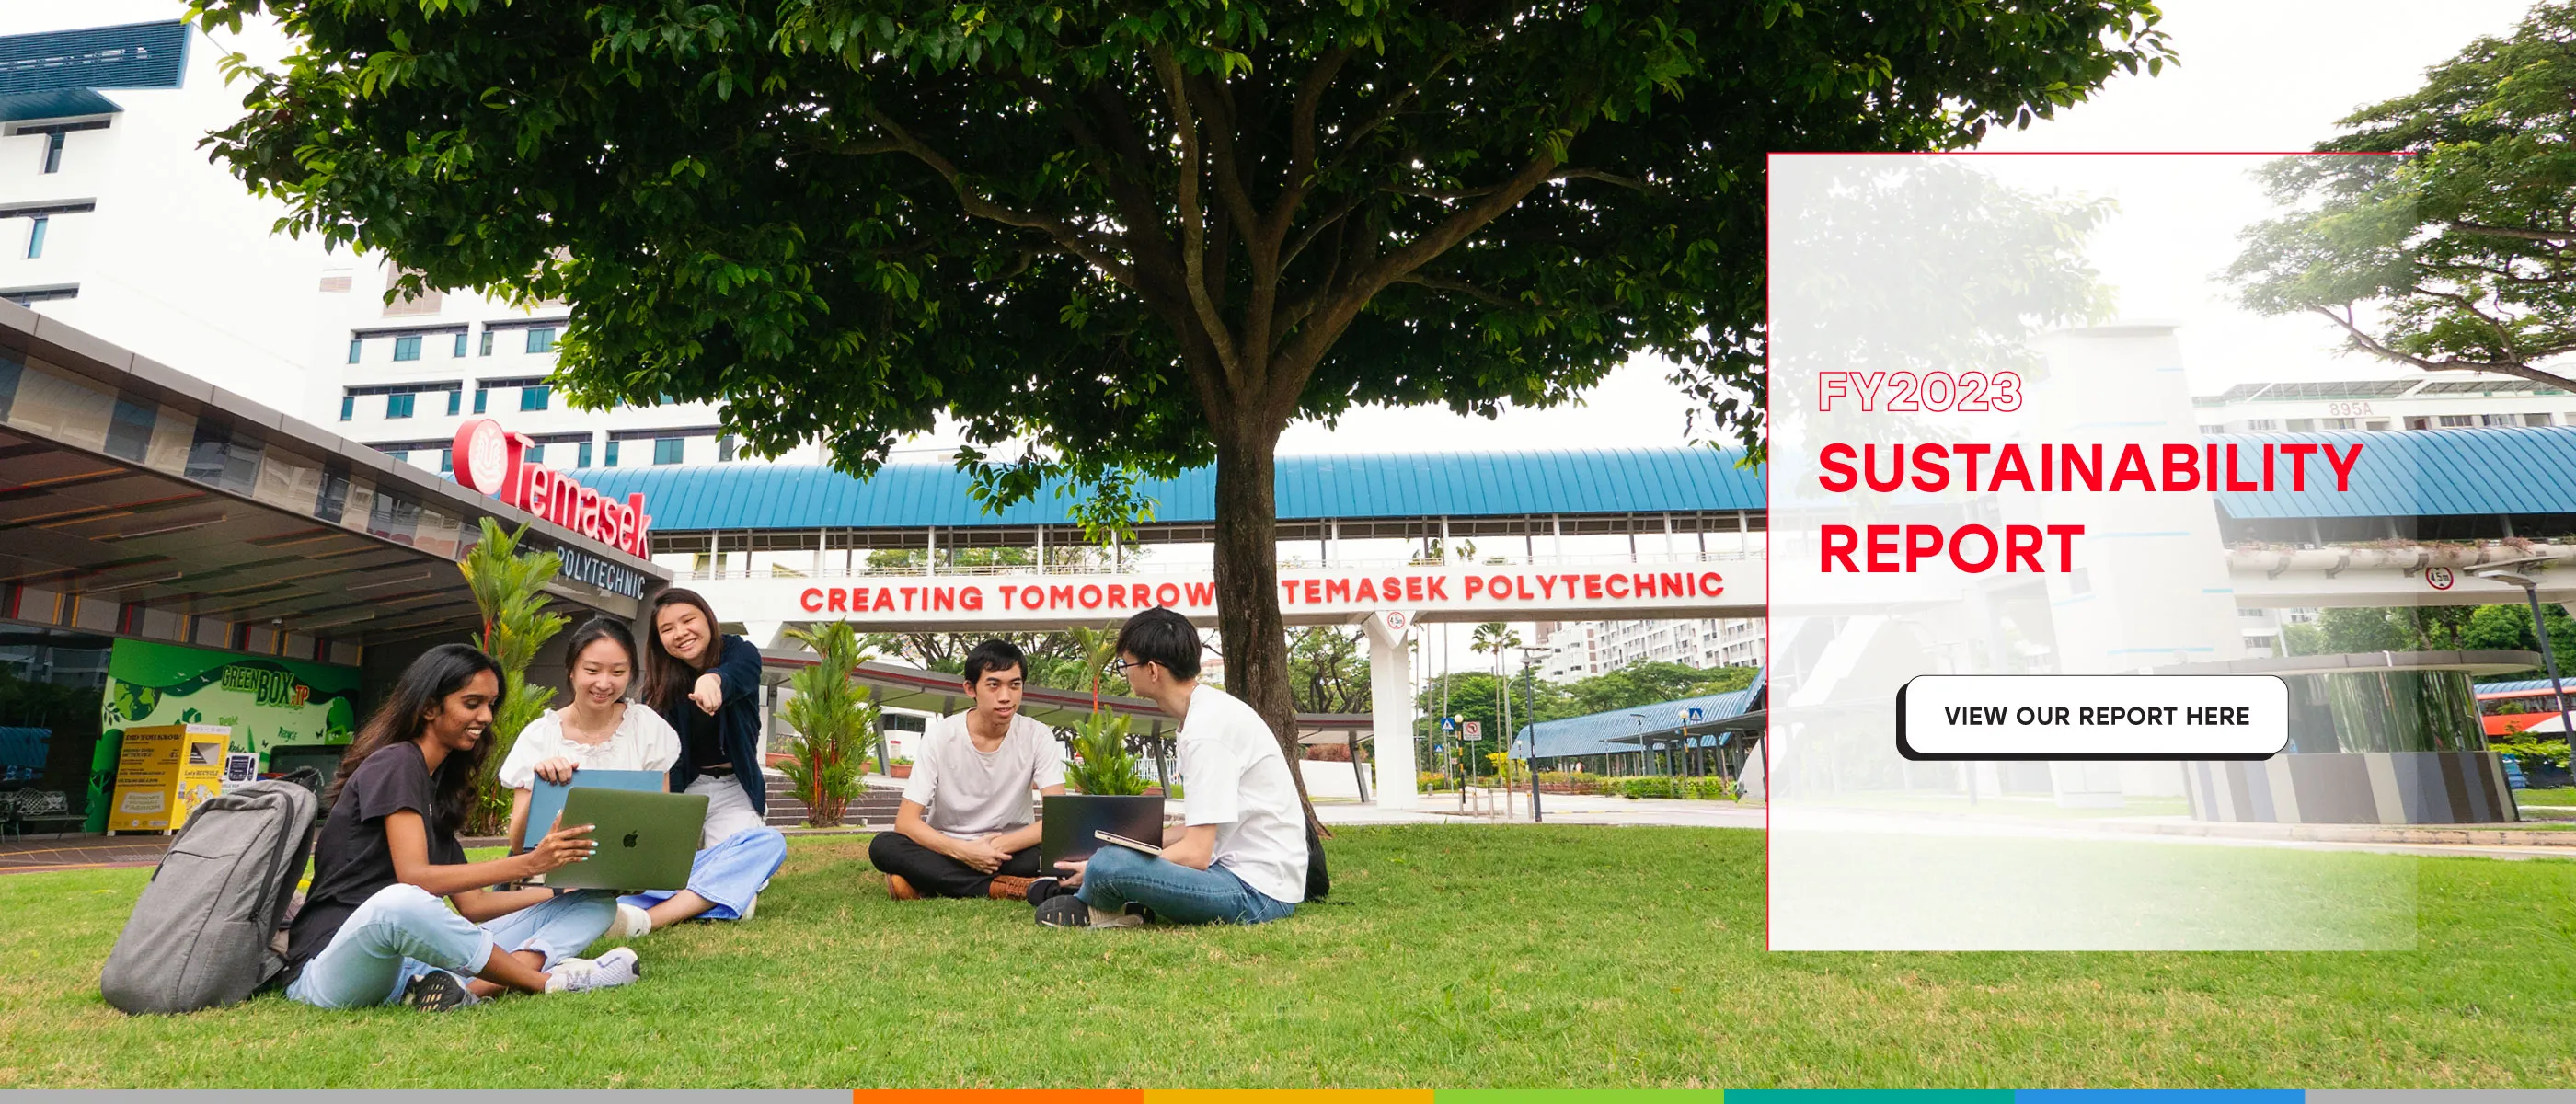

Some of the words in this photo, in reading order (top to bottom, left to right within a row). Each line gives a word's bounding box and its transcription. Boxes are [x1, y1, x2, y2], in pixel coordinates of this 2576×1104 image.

[2329, 402, 2374, 416] 895A
[502, 431, 652, 560] Temasek
[558, 546, 646, 600] POLYTECHNIC
[800, 586, 983, 613] CREATING
[998, 581, 1216, 610] TOMORROW
[1282, 576, 1448, 604] TEMASEK
[1465, 571, 1724, 600] POLYTECHNIC
